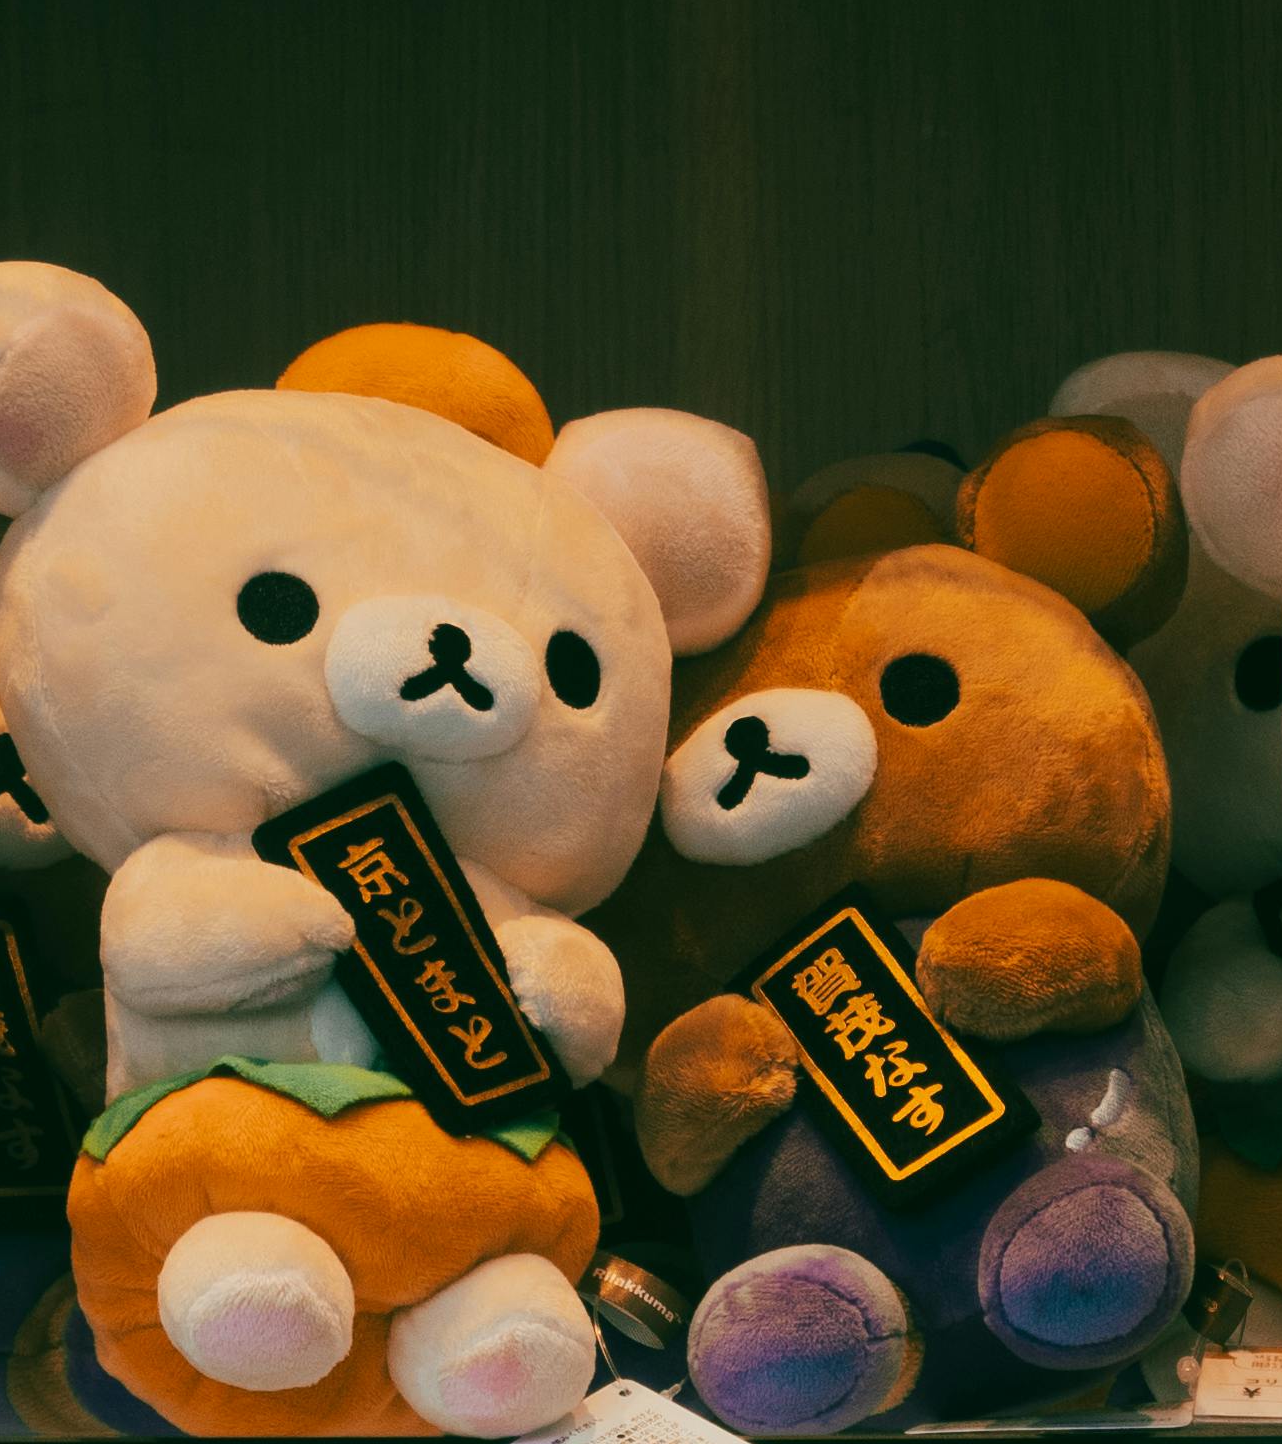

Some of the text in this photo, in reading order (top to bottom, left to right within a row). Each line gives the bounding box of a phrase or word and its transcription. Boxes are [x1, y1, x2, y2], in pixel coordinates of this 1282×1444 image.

[337, 836, 507, 1070] 京とまと
[791, 948, 947, 1137] 賀茂なす
